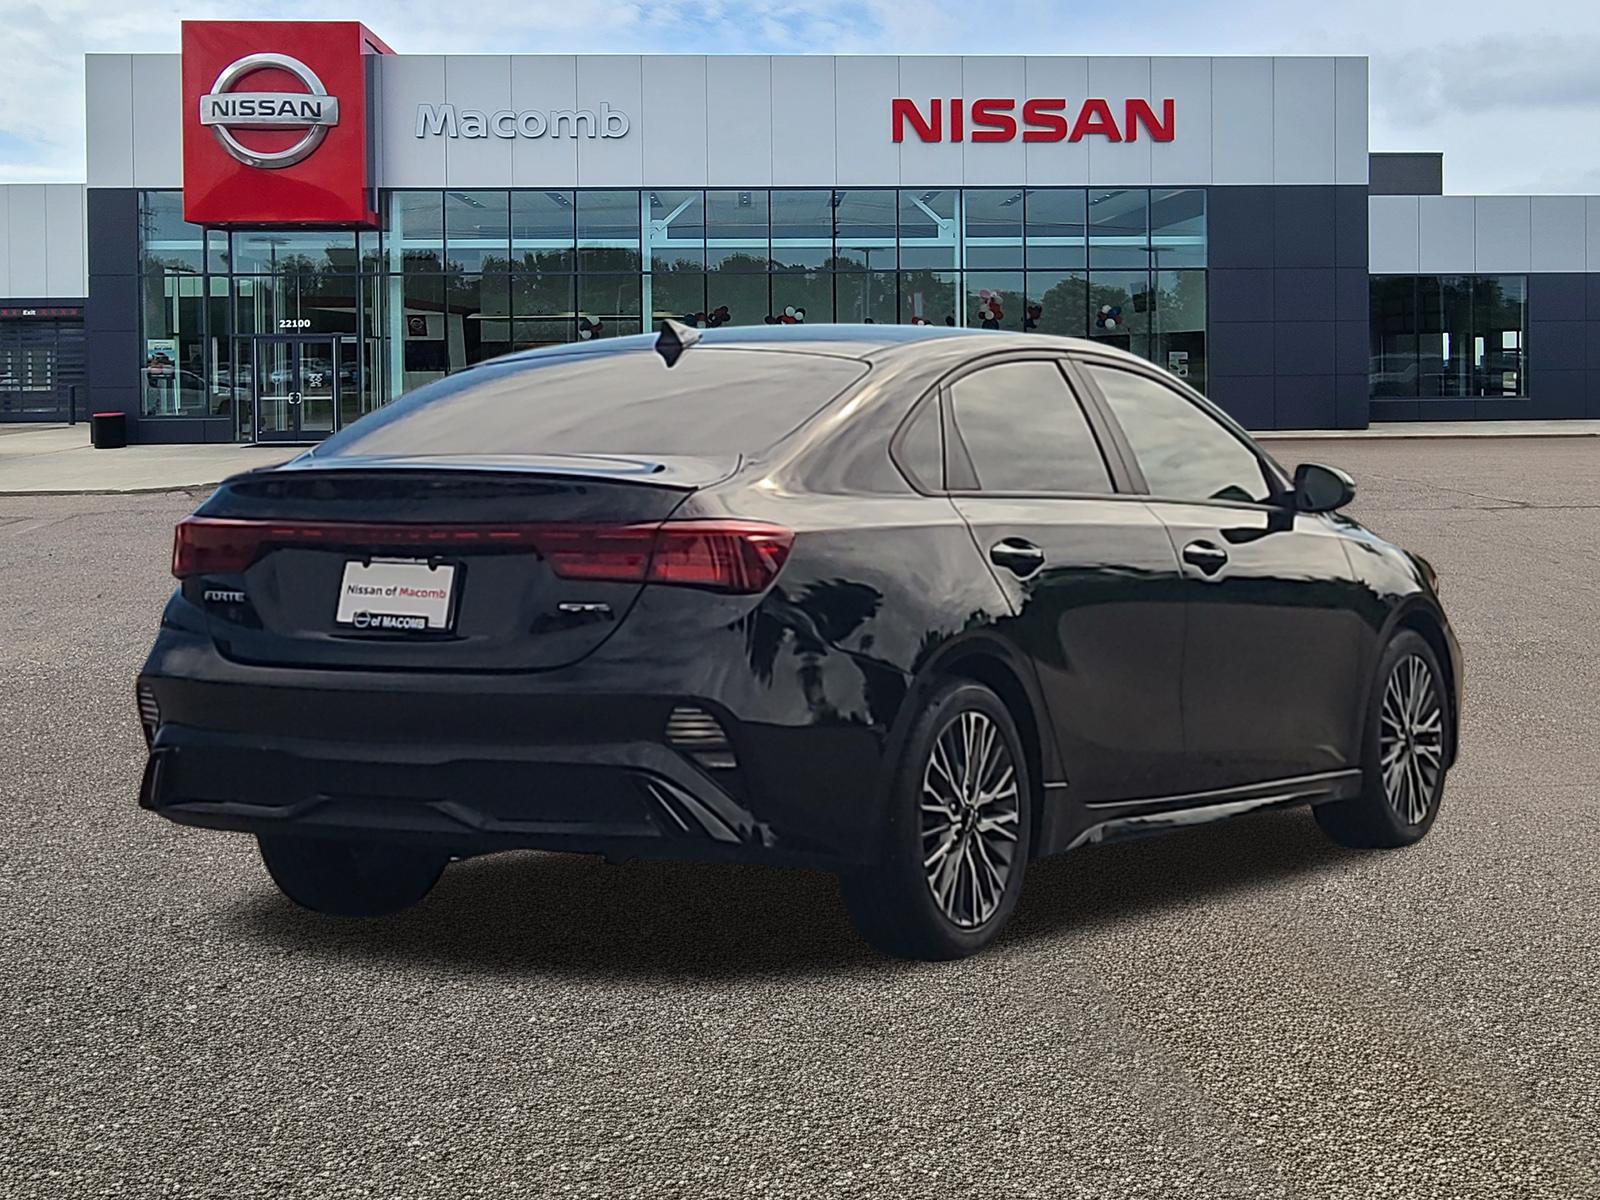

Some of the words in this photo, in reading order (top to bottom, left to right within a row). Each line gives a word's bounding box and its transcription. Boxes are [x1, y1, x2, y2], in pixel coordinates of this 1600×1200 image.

[212, 100, 322, 118] NISSAN
[415, 102, 630, 138] Macomb
[892, 98, 1175, 143] NISSAN
[279, 319, 311, 328] 22100
[204, 590, 245, 602] FORTE
[347, 584, 383, 596] Nissan
[385, 586, 397, 597] of
[399, 587, 447, 599] Macomb
[370, 616, 381, 627] of
[382, 616, 425, 629] MACOMB
